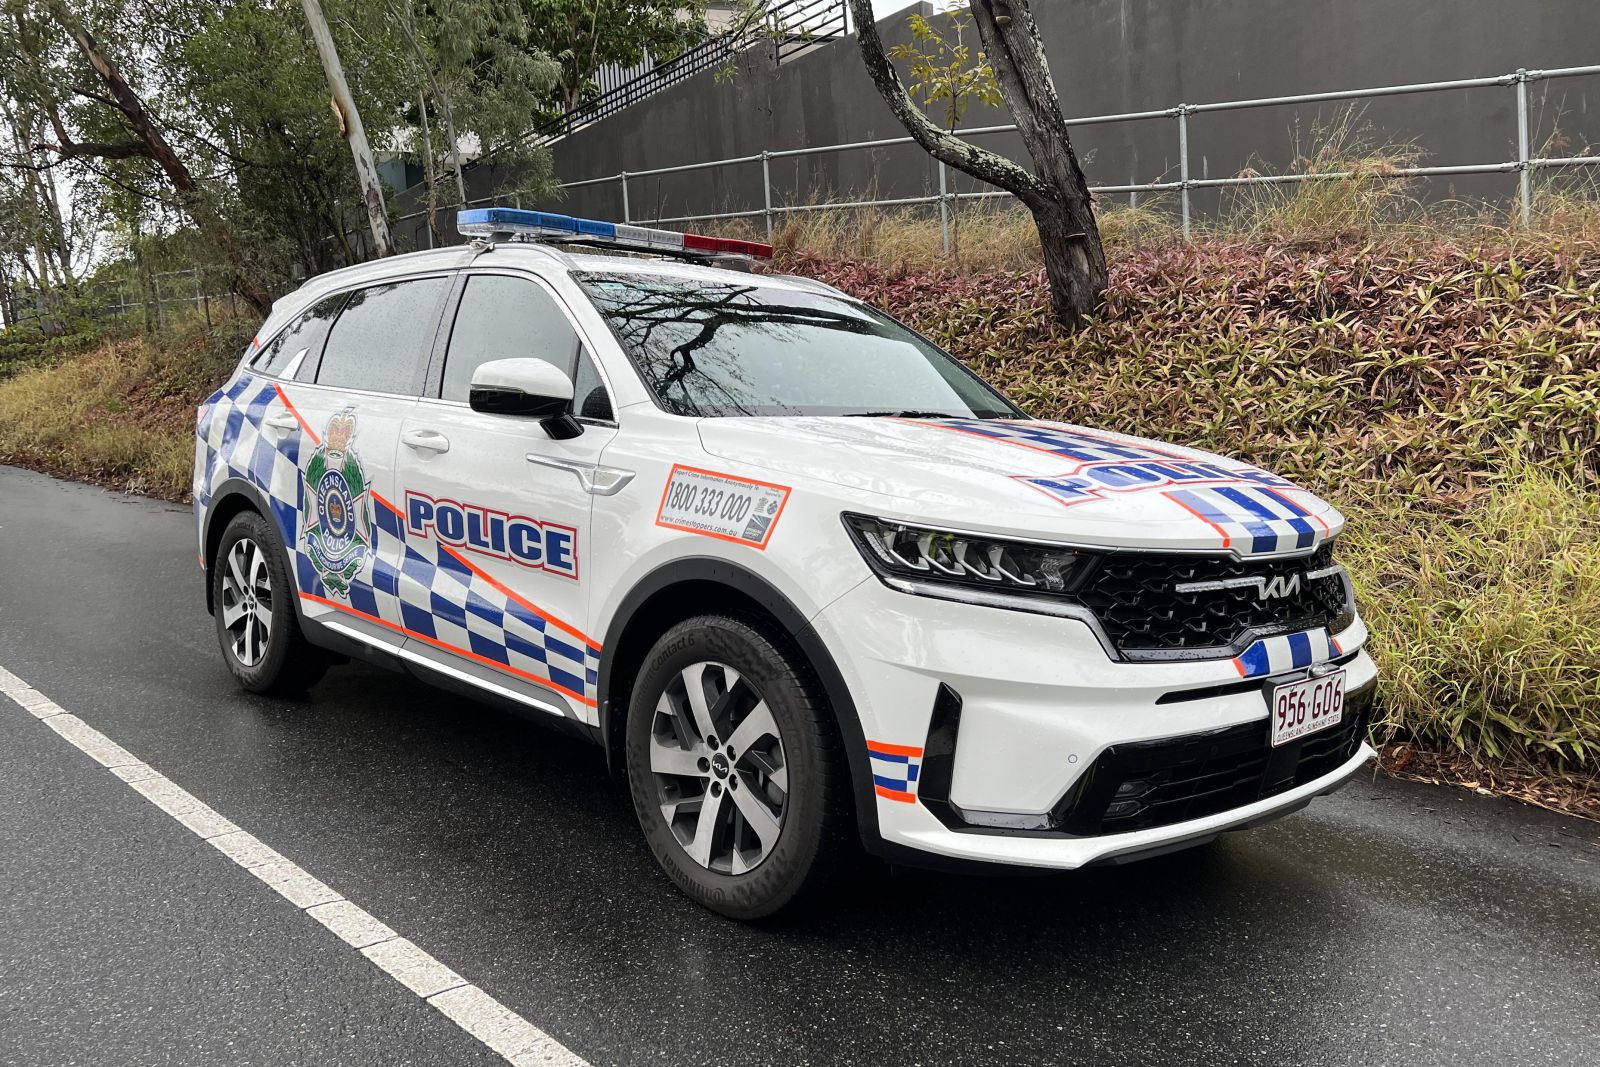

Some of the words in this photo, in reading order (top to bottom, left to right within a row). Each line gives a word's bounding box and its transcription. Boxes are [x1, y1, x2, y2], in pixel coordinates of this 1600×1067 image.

[319, 475, 353, 522] QUEENSLAND
[1024, 461, 1296, 499] POLICE
[666, 481, 697, 511] 1800
[695, 487, 723, 516] 333
[720, 493, 751, 522] 000
[324, 529, 350, 550] POLICE
[408, 497, 573, 571] POLICE
[661, 515, 737, 537] www.crimestoppers.com.au
